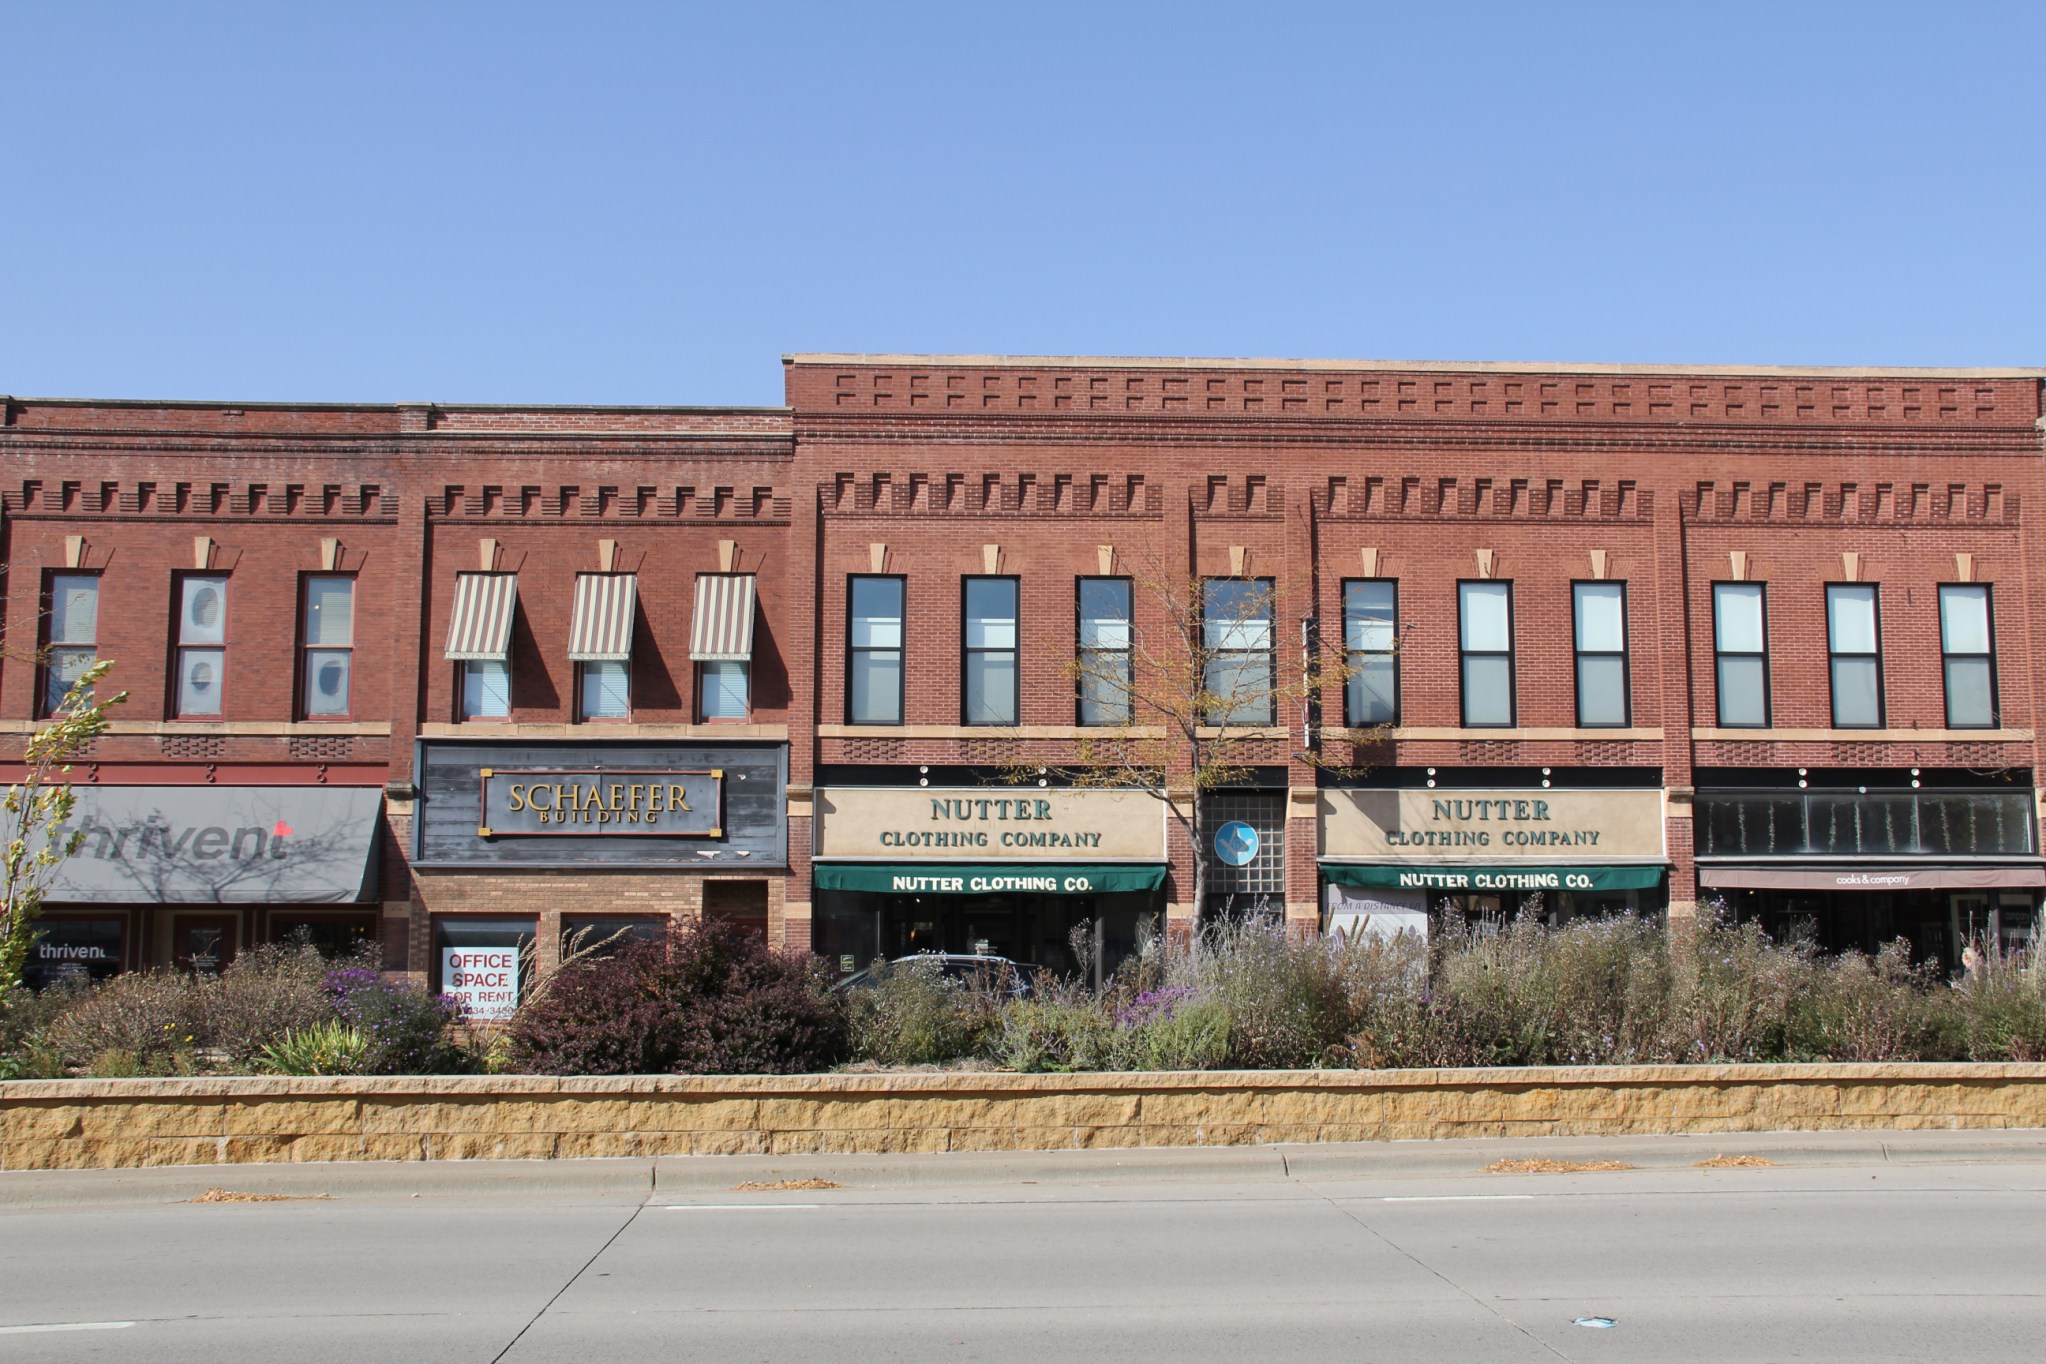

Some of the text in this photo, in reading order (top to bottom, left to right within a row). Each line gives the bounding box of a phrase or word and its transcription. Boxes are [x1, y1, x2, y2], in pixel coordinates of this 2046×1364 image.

[509, 784, 692, 812] SCHAEFER
[540, 811, 658, 824] BUILDING
[930, 799, 1052, 820] NUTTER
[1432, 799, 1551, 821] NUTTER
[53, 814, 293, 860] thrivent
[879, 831, 1102, 848] CLOTHING COMPANY
[1385, 830, 1600, 846] CLOTHING COMPANY
[893, 876, 1093, 892] NUTTER CLOTHING CO.
[1400, 873, 1593, 889] NUTTER CLOTHING CO.
[1836, 873, 1909, 886] cooks & company
[40, 943, 106, 959] thrivent
[449, 954, 512, 968] OFFICE
[452, 973, 508, 987] SPACE
[478, 991, 513, 1002] RENT
